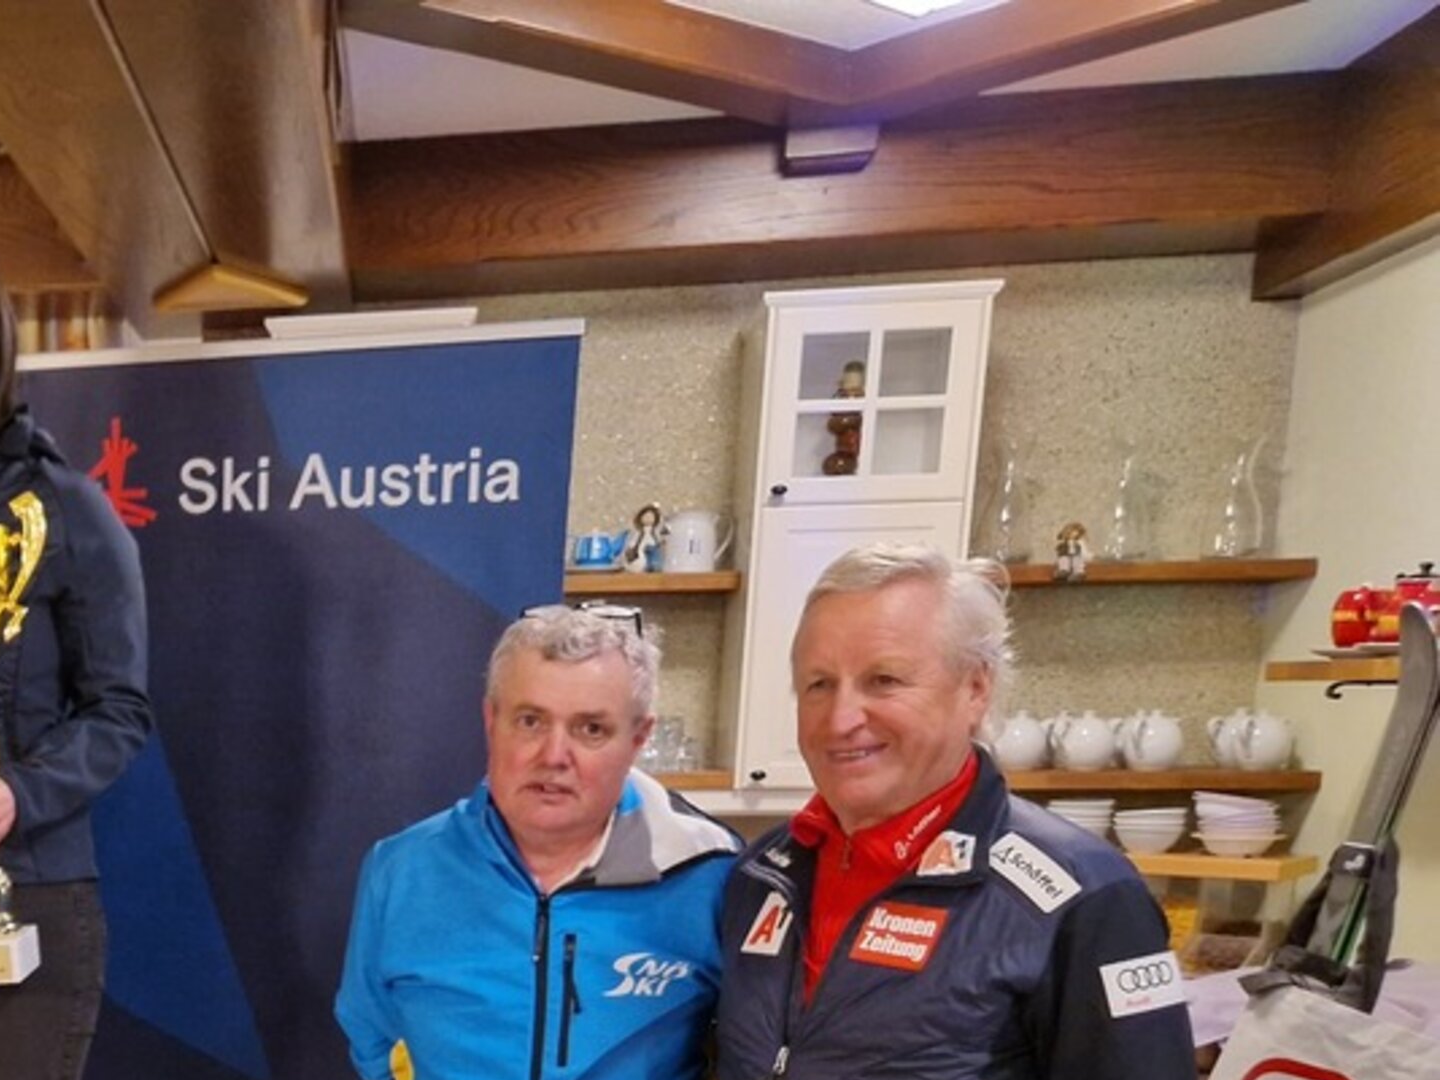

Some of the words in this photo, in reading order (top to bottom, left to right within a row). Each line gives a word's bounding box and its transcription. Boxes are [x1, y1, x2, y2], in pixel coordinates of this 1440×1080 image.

[179, 456, 271, 515] Ski
[289, 447, 521, 511] Austria
[868, 906, 938, 938] Kronen
[858, 930, 928, 963] Zeitung
